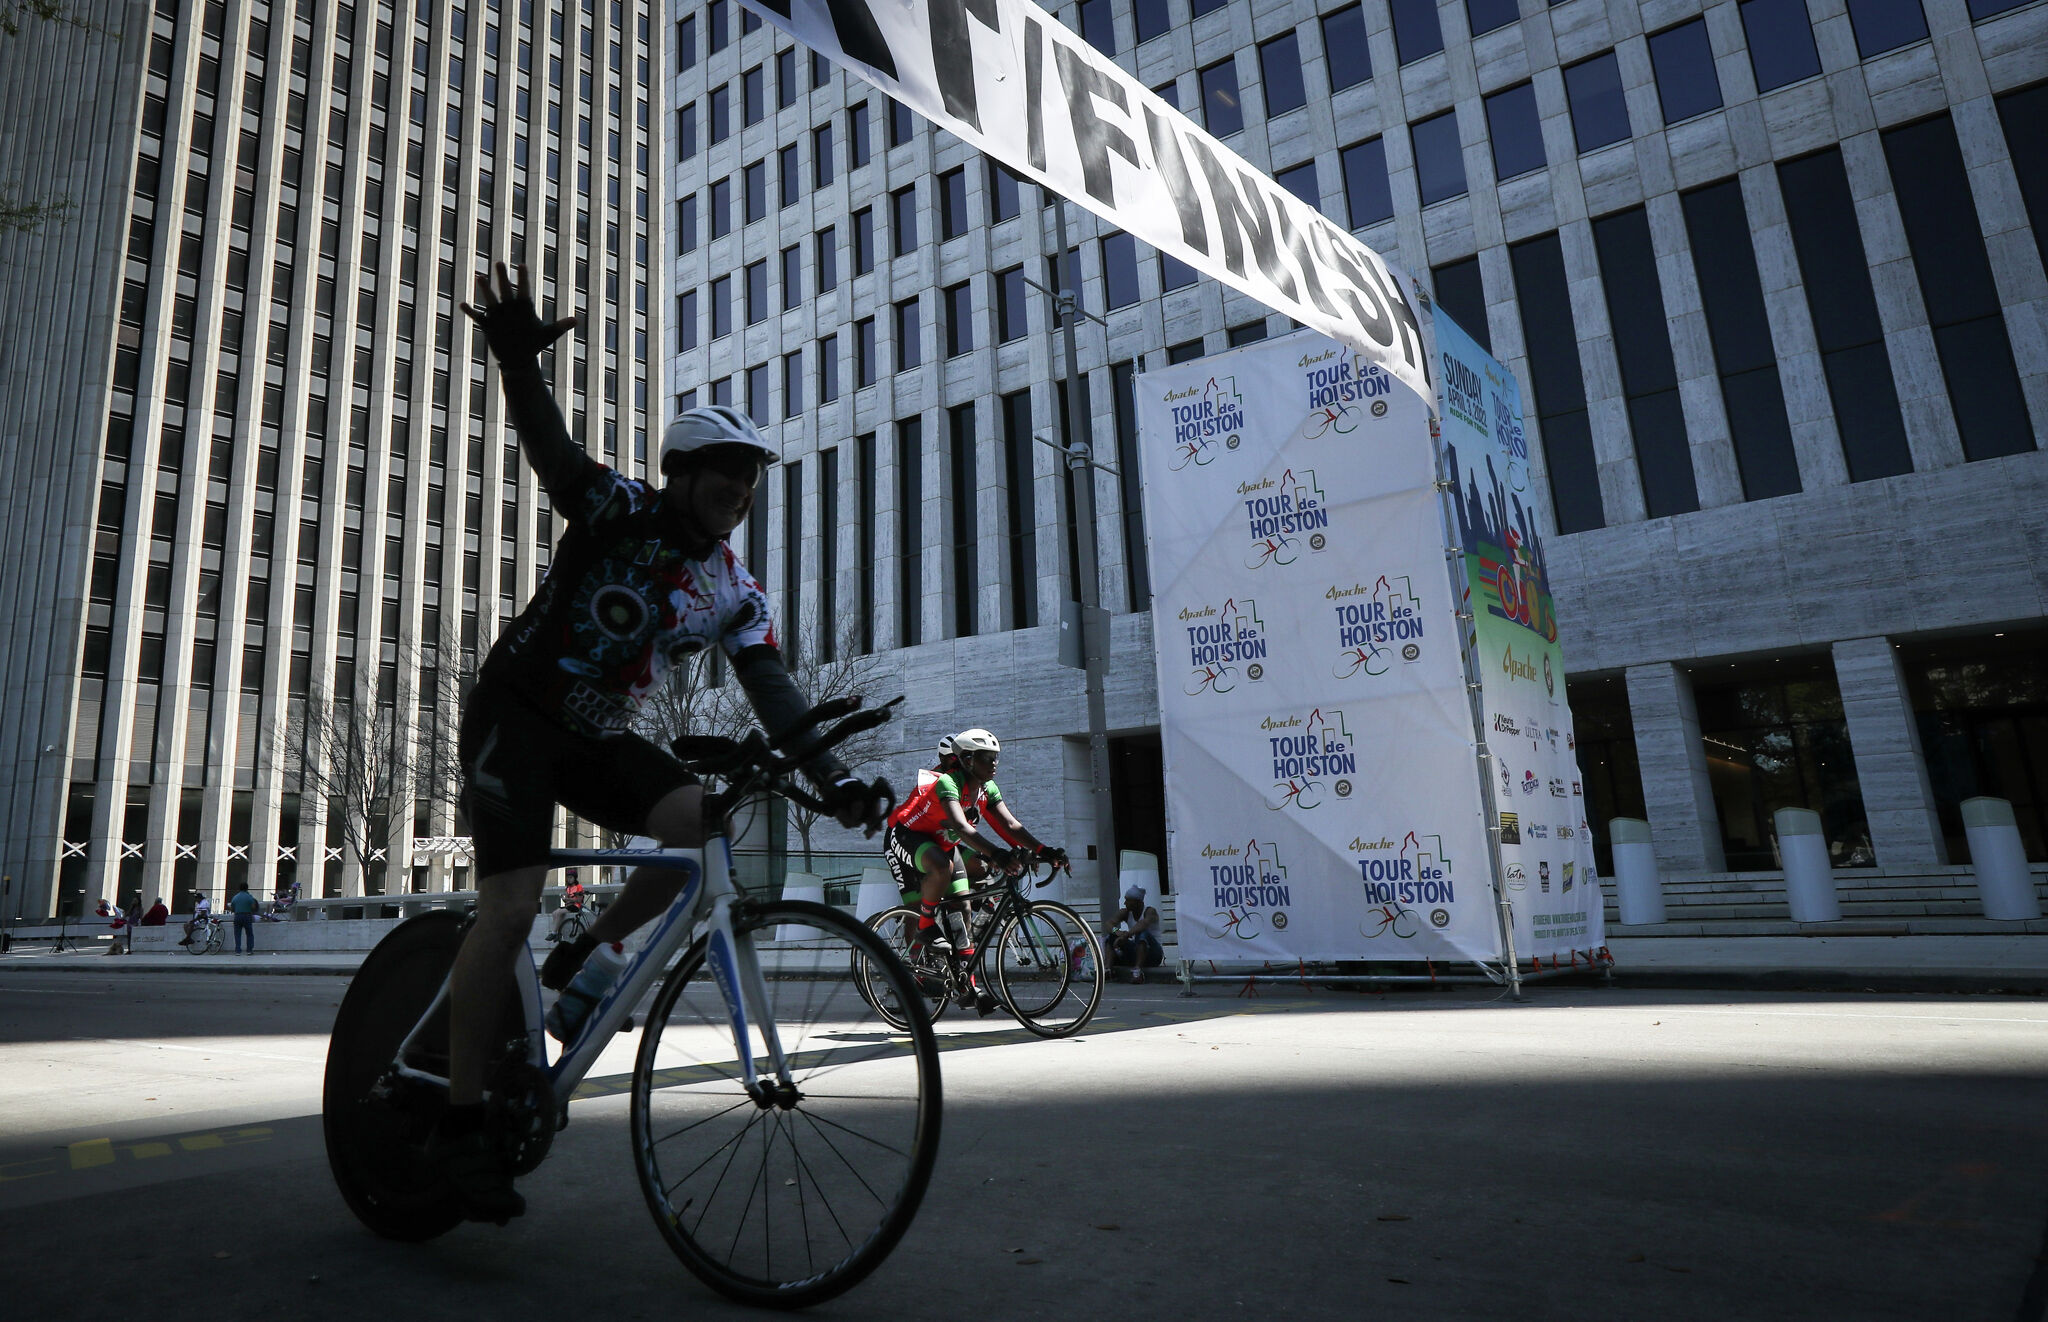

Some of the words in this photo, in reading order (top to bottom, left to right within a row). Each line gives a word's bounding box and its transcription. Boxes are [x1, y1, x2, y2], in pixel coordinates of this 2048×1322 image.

[1051, 37, 1434, 390] FINISH
[1298, 349, 1336, 367] Apache
[1306, 363, 1352, 390] TOUR
[1359, 366, 1379, 378] de
[1443, 352, 1484, 407] SUNDAY
[1163, 386, 1200, 402] Apache
[1310, 374, 1391, 409] HOUSTON
[1448, 386, 1467, 413] APRIL
[1171, 401, 1213, 424] TOUR
[1219, 403, 1235, 414] de
[1175, 411, 1243, 443] HOUSTON
[1237, 477, 1275, 495] Apache
[1245, 495, 1292, 519] TOUR
[1299, 498, 1317, 510] de
[1250, 508, 1328, 539] HOUSTON
[1326, 583, 1367, 600] Apache
[1179, 605, 1217, 621] Apache
[1335, 602, 1386, 626] TOUR
[1393, 606, 1412, 619] de
[1187, 623, 1232, 645] TOUR
[1238, 628, 1257, 640] de
[1340, 617, 1423, 647] HOUSTON
[1191, 639, 1267, 666] HOUSTON
[1503, 642, 1537, 682] Apache
[1261, 715, 1302, 731] Apache
[1270, 735, 1319, 757] TOUR
[1325, 741, 1345, 753] de
[1273, 753, 1356, 779] HOUSTON
[890, 826, 914, 868] KENYA
[1201, 843, 1240, 859] Apache
[1349, 836, 1394, 853] Apache
[884, 849, 906, 891] KENYA
[1210, 865, 1256, 886] TOUR
[1262, 872, 1280, 884] de
[1358, 860, 1413, 880] TOUR
[1420, 867, 1443, 880] de
[1214, 885, 1290, 908] HOUSTON
[1364, 881, 1455, 904] HOUSTON
